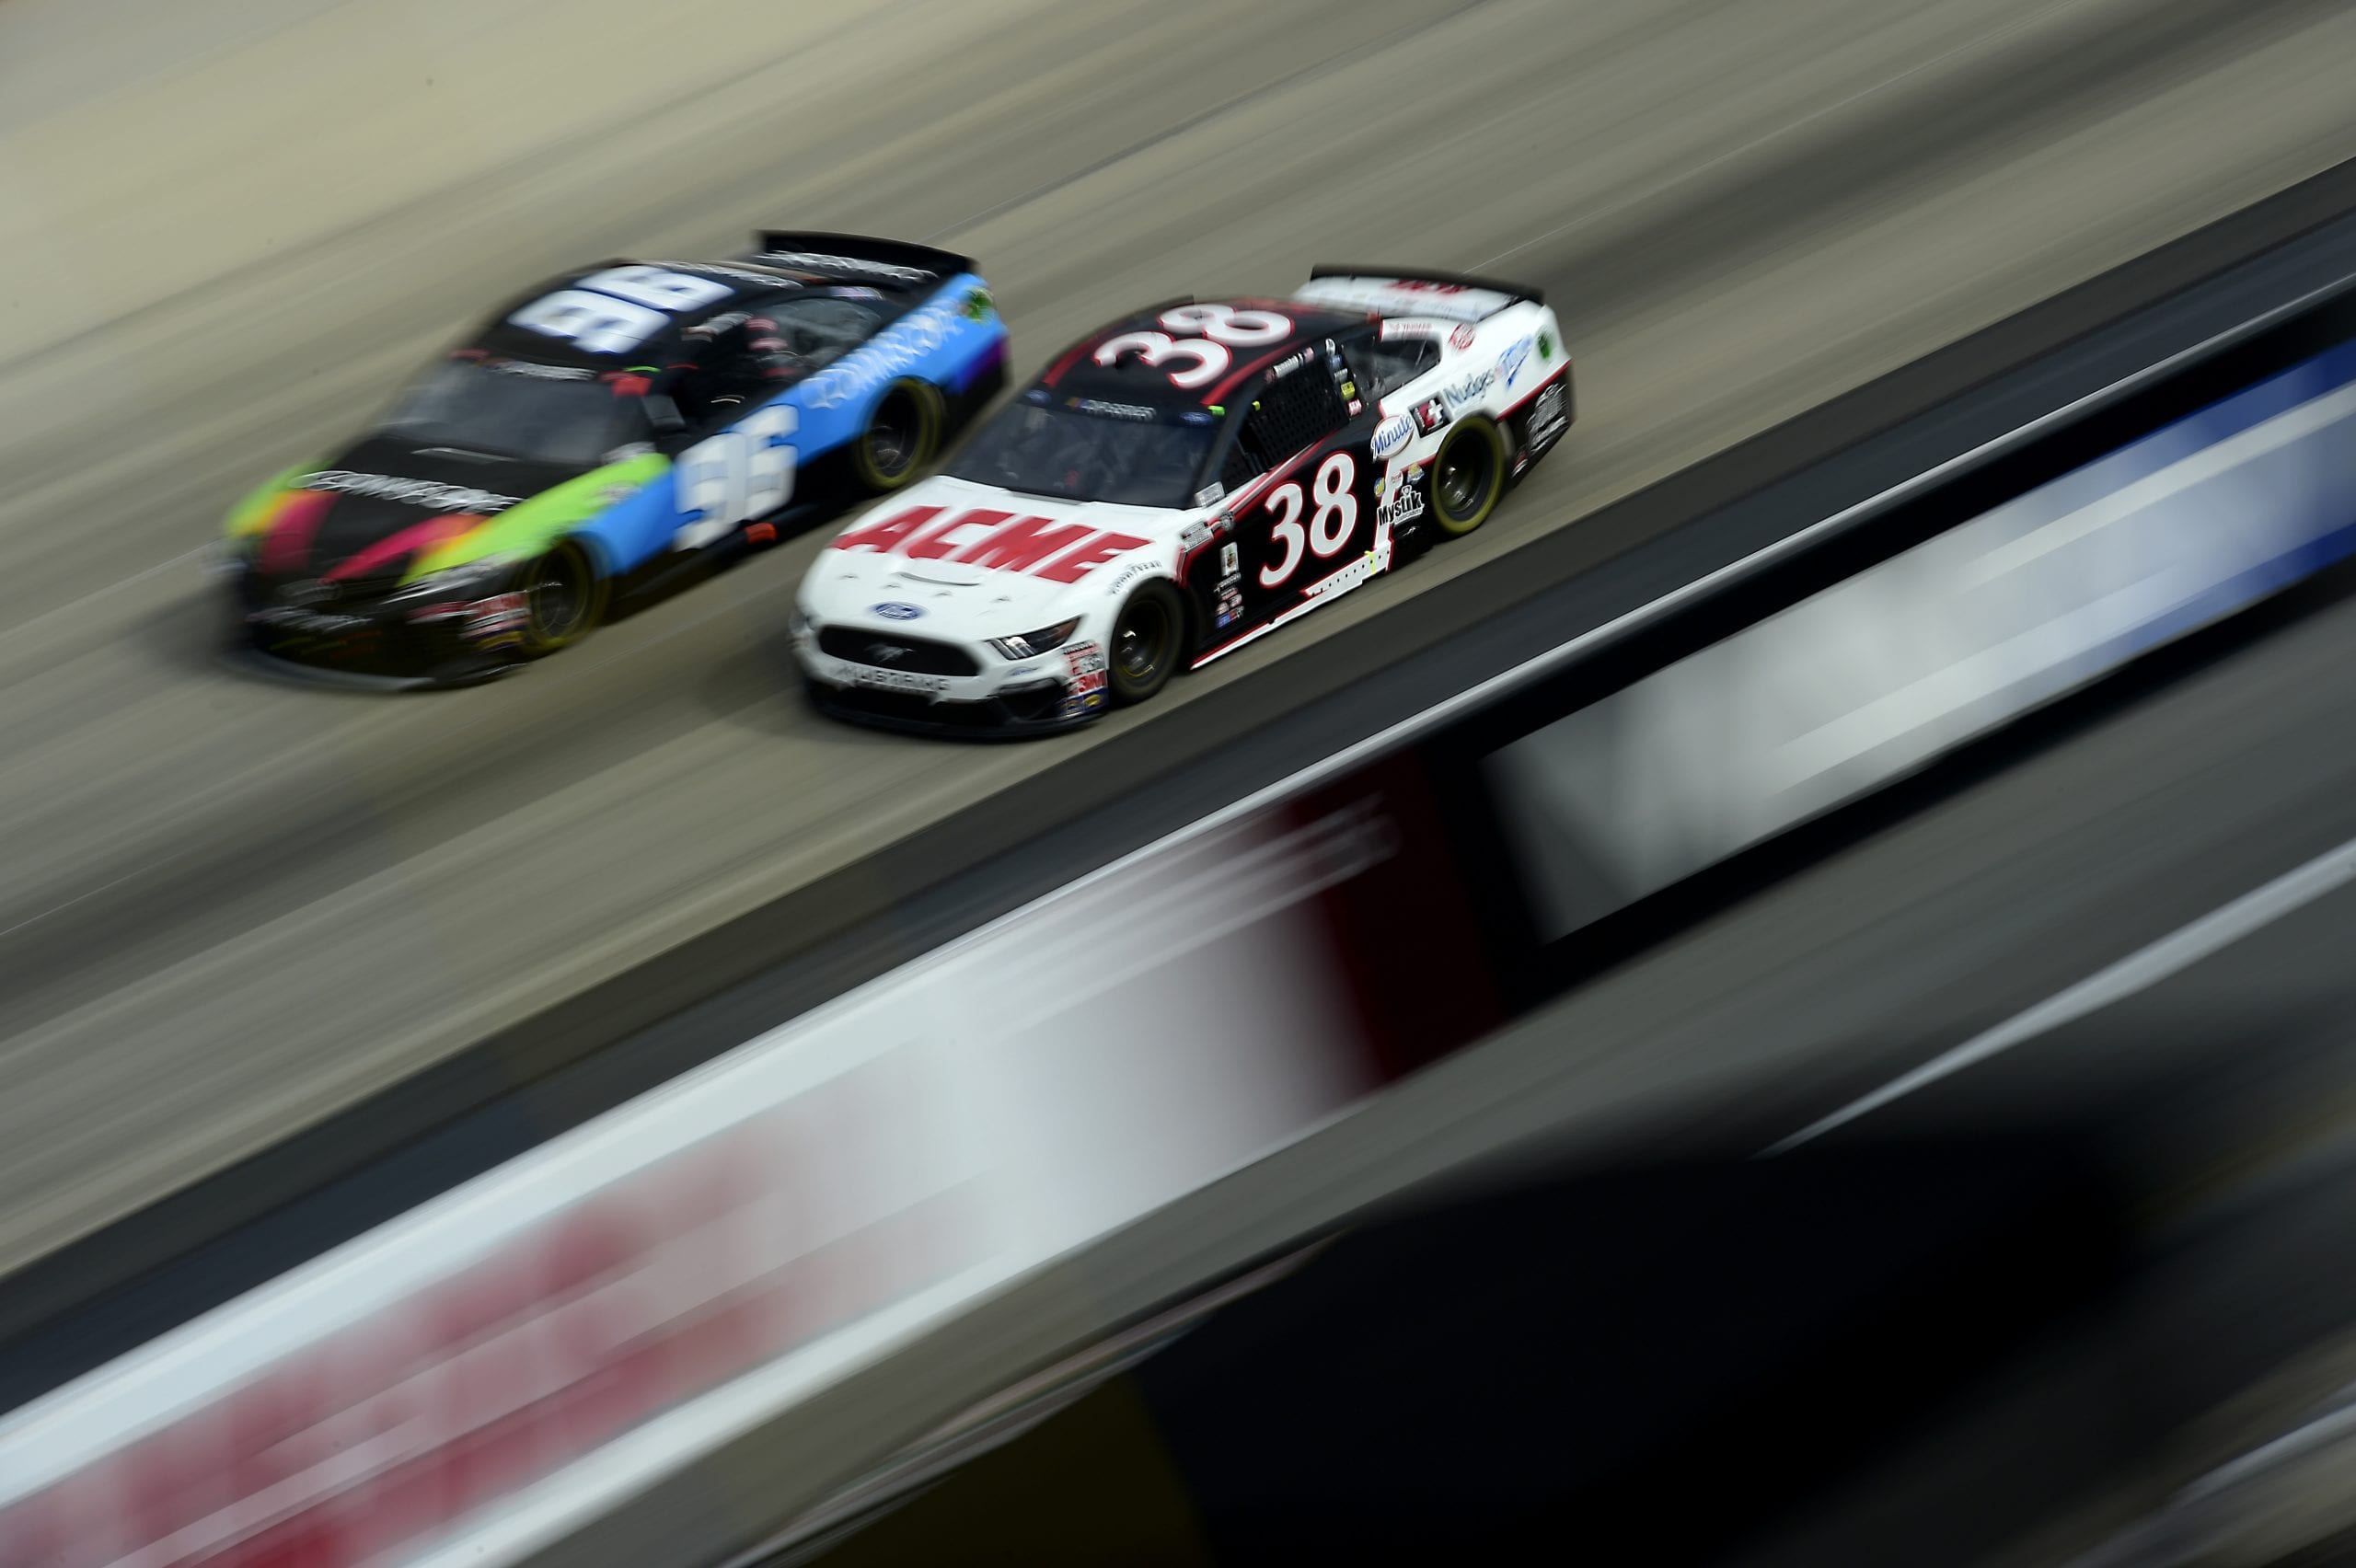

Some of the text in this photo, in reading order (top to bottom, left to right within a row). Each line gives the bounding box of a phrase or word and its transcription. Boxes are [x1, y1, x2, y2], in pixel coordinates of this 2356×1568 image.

[1092, 304, 1294, 388] 38
[670, 403, 800, 553] 96
[1372, 415, 1414, 460] Minute
[833, 505, 1154, 583] ACME
[1259, 451, 1357, 586] 38
[1378, 489, 1424, 527] Mystik
